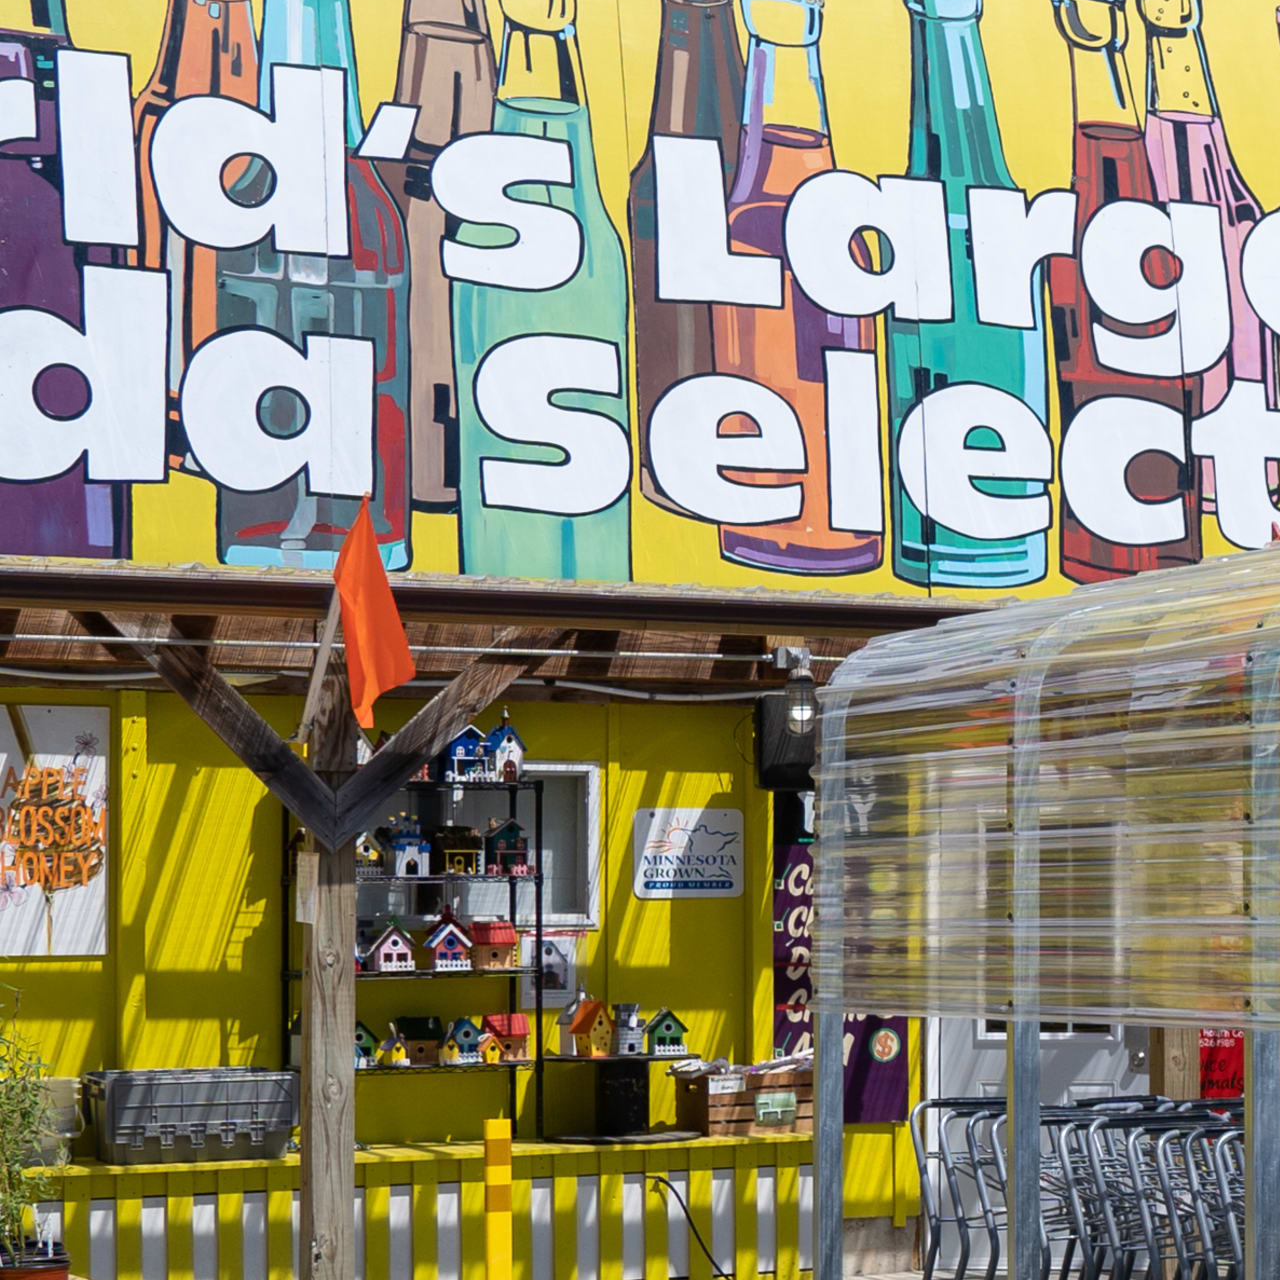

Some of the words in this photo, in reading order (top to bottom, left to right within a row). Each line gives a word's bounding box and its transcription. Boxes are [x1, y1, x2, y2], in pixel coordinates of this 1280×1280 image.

[1, 765, 88, 800] APPLE
[0, 851, 96, 888] HONEY
[643, 854, 737, 866] MINNESOTA
[643, 867, 705, 879] GROWN
